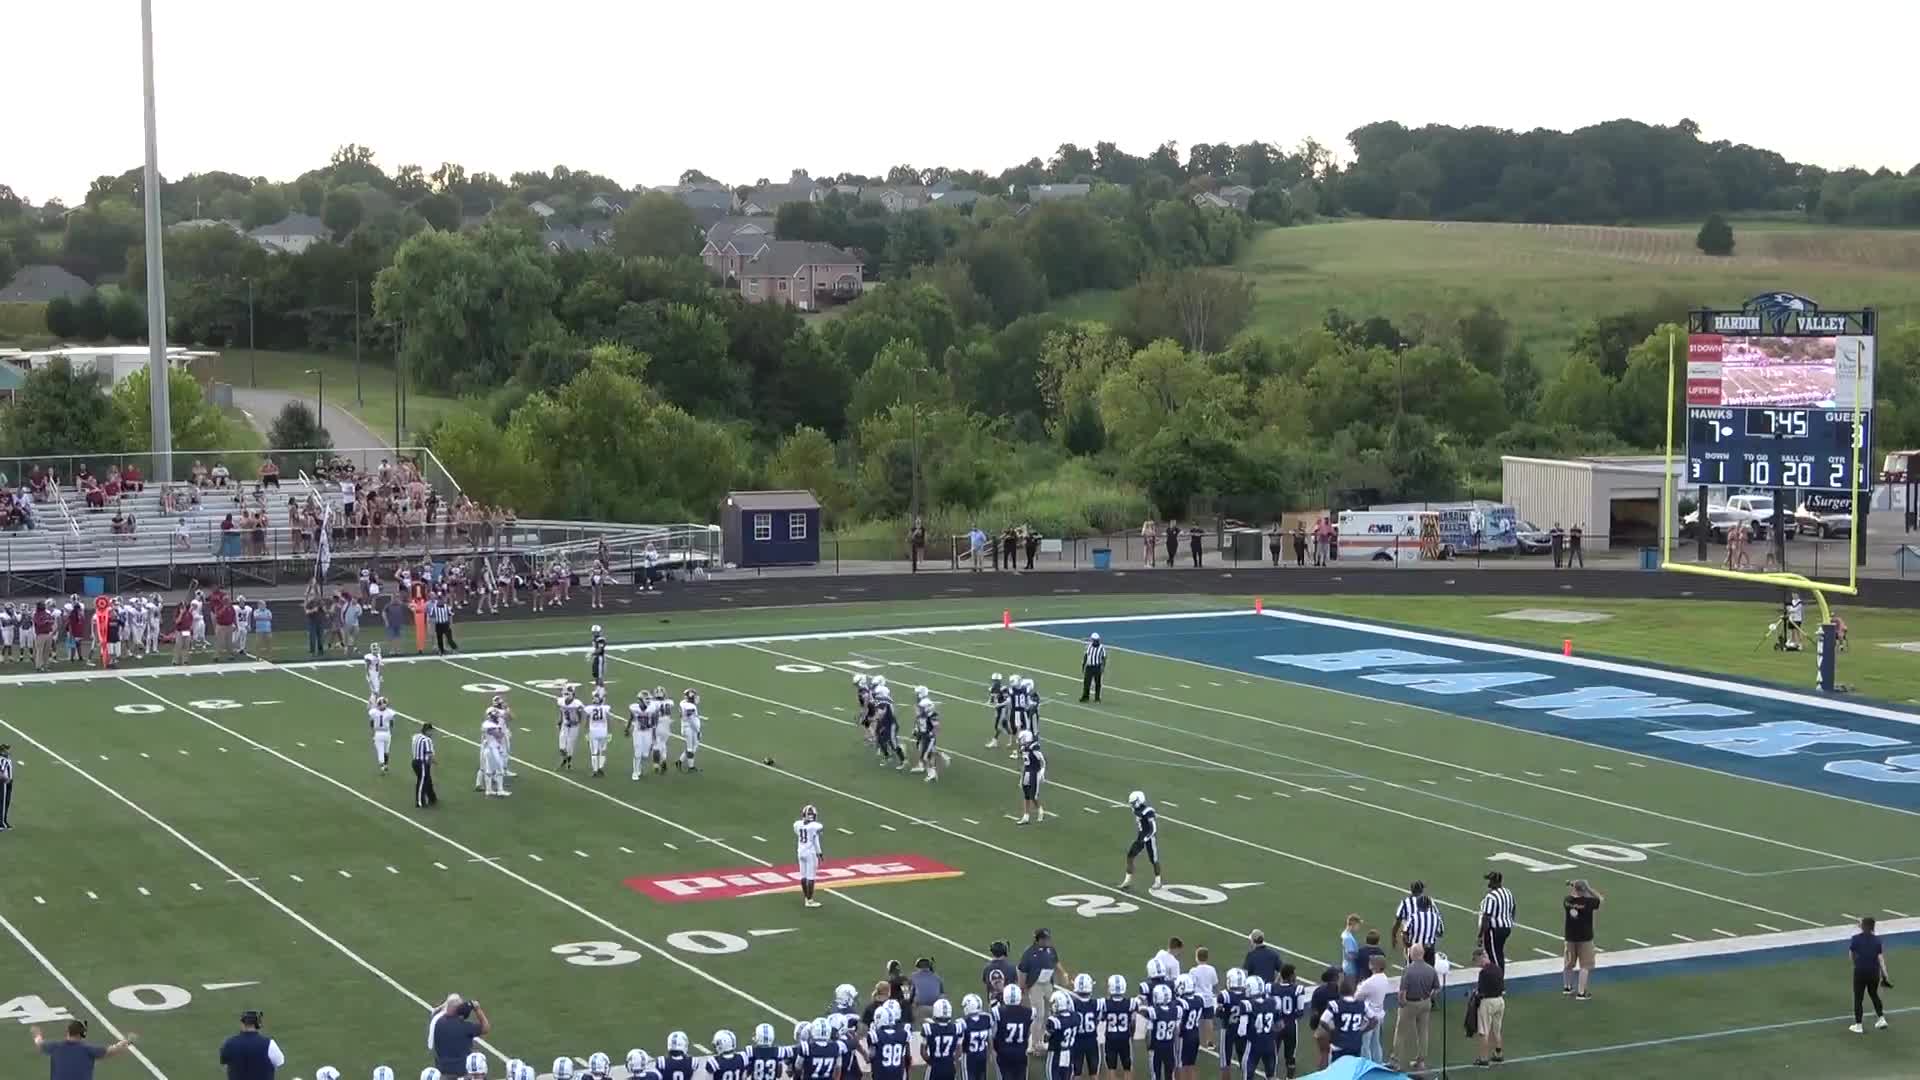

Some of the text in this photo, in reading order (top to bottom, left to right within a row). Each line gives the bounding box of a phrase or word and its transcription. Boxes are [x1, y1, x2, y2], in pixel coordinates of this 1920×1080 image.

[1715, 317, 1846, 330] HARDIN VALLEY
[1697, 344, 1722, 353] DOWN
[1688, 386, 1720, 395] LIFETIME
[1691, 409, 1733, 420] HAWKS
[1763, 410, 1806, 435] 7:45
[1709, 420, 1720, 443] 7
[1781, 455, 1800, 463] BALL
[1828, 456, 1846, 464] QTR
[1692, 463, 1700, 478] 3
[1750, 462, 1770, 485] 10
[1783, 463, 1811, 486] 20
[1829, 464, 1844, 487] 2
[1813, 495, 1851, 510] Surger
[1368, 524, 1393, 533] AMR
[799, 828, 808, 844] 11
[1485, 843, 1648, 873] 10
[1046, 883, 1229, 918] 20
[550, 930, 748, 968] 30
[0, 983, 192, 1025] 40
[1006, 1023, 1025, 1043] 71
[1107, 1012, 1129, 1033] 23
[1255, 1013, 1274, 1034] 43
[1340, 1013, 1362, 1032] 72
[881, 1043, 903, 1067] 98
[934, 1035, 954, 1057] 17
[811, 1057, 835, 1078] 77
